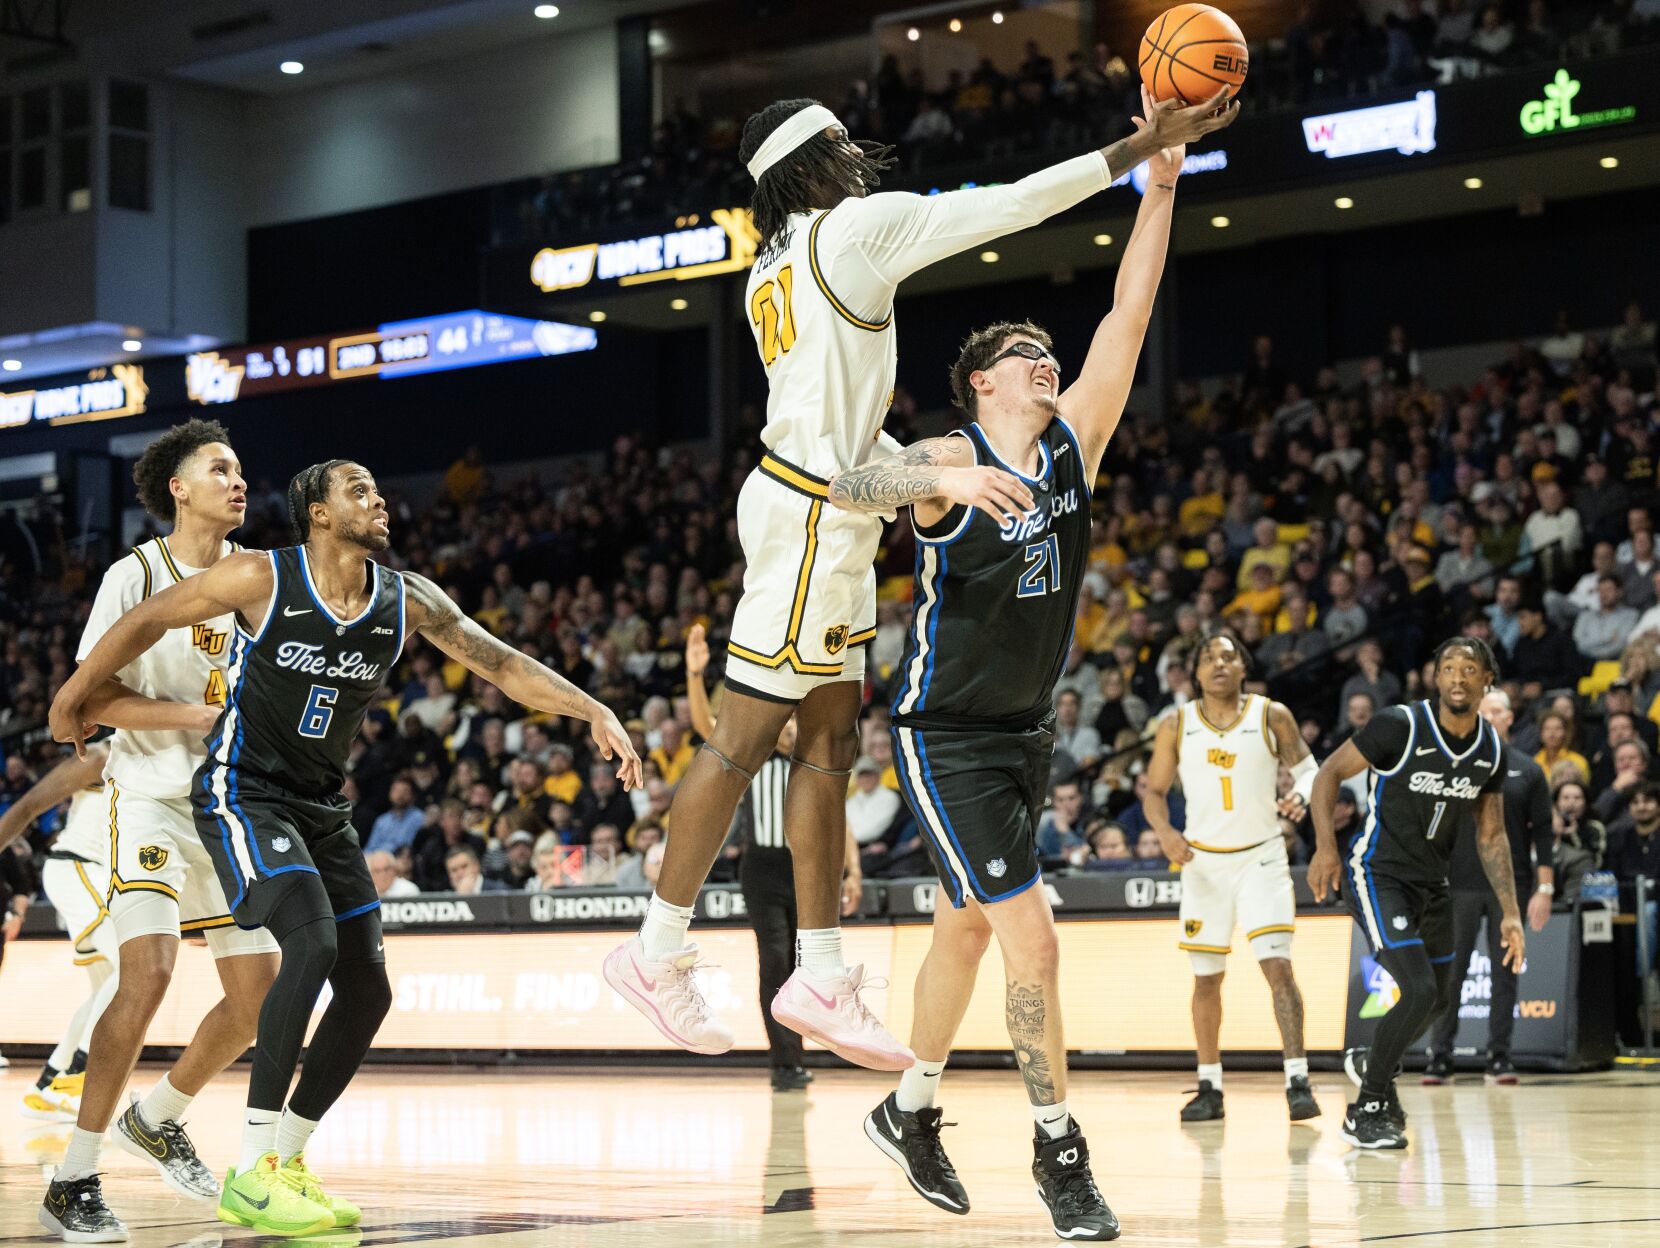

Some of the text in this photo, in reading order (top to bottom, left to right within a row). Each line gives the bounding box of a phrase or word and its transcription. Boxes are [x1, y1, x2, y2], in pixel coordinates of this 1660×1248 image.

[1519, 97, 1580, 135] GFL
[1000, 488, 1078, 541] The ou
[1016, 532, 1061, 599] 21
[191, 624, 227, 656] VCU
[276, 641, 380, 681] The Lou
[204, 669, 227, 708] 4
[298, 684, 340, 739] 6
[1207, 748, 1237, 770] VCU
[1219, 776, 1234, 811] 1
[1408, 771, 1482, 800] The Lou
[1426, 801, 1447, 840] 1
[381, 901, 475, 923] HONDA
[553, 896, 650, 919] HONDA
[513, 971, 600, 1010] FIND
[1010, 998, 1045, 1008] THINGS
[1519, 1000, 1556, 1018] VCU
